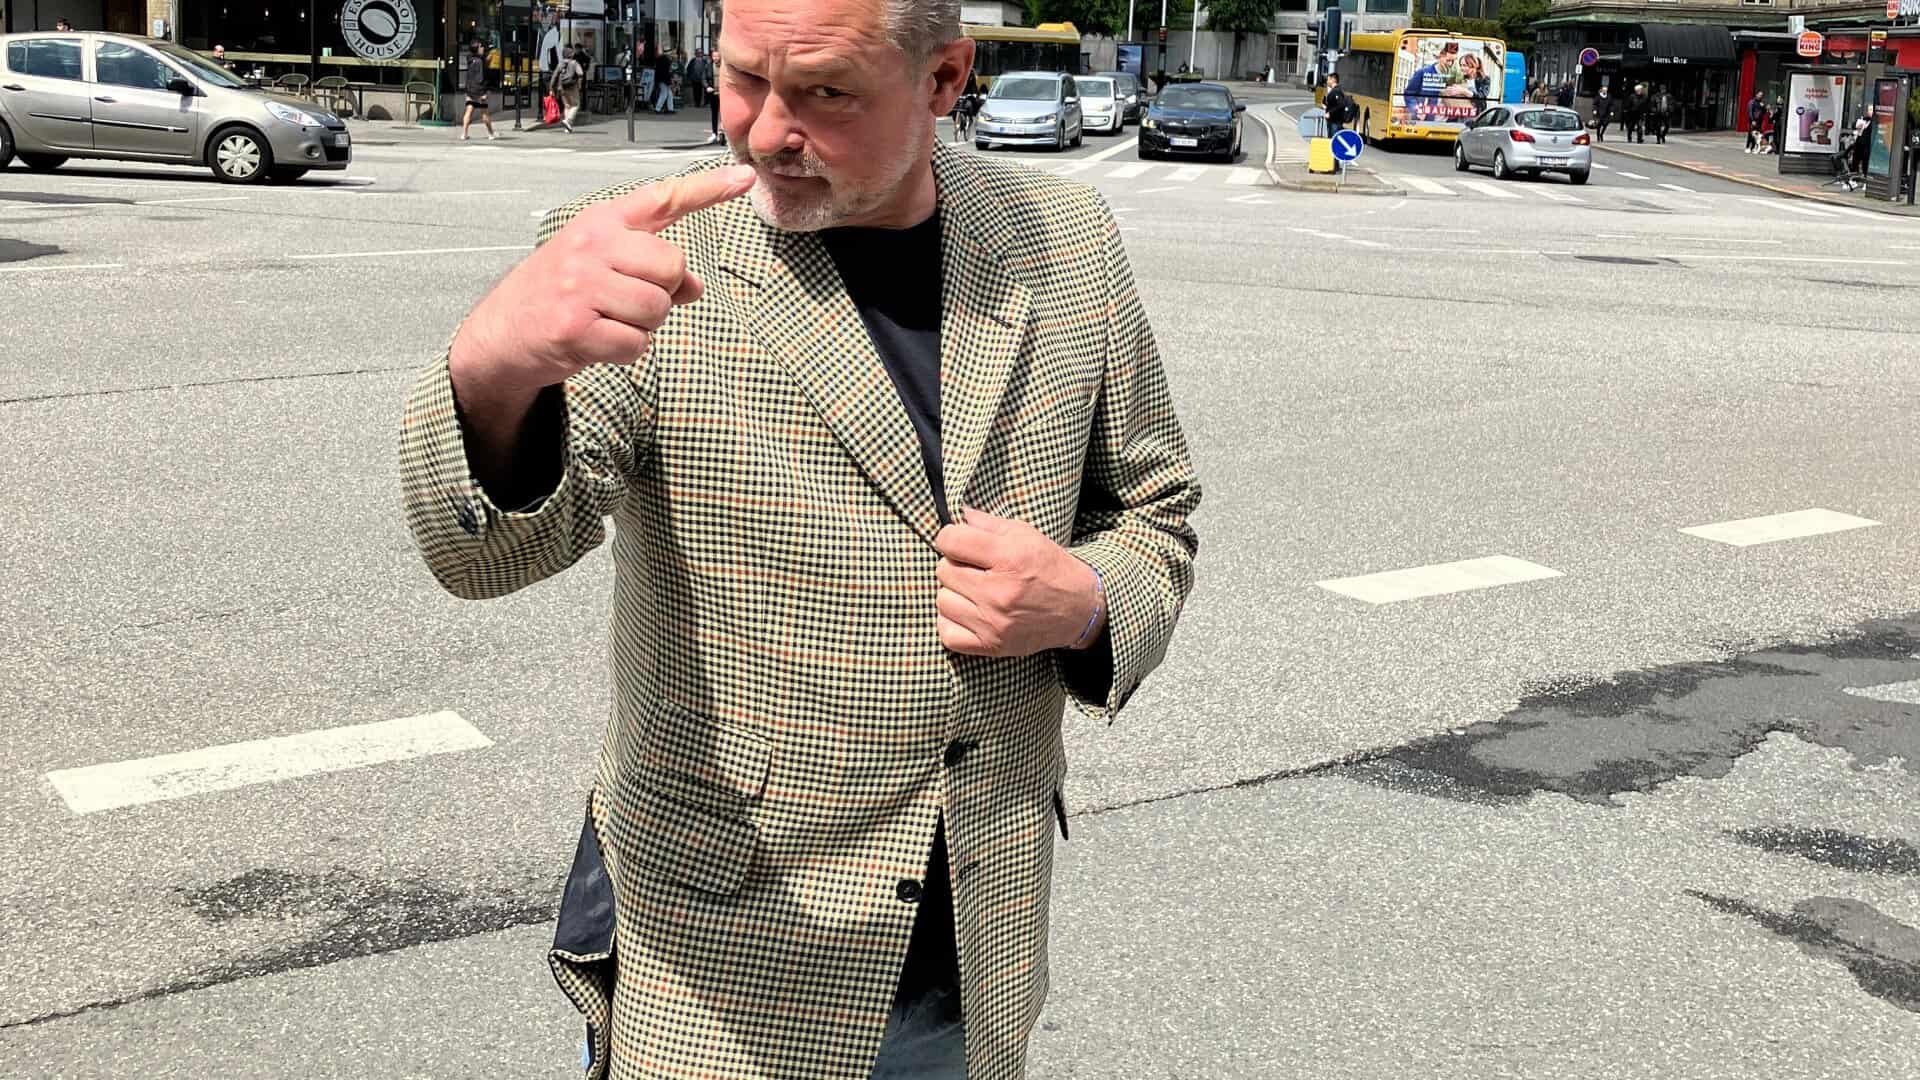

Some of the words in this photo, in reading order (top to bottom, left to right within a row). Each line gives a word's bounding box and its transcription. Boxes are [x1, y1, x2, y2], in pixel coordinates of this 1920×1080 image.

[349, 0, 409, 17] ESSO
[354, 39, 401, 56] HOUSE
[1425, 105, 1477, 116] BAUHAUS
